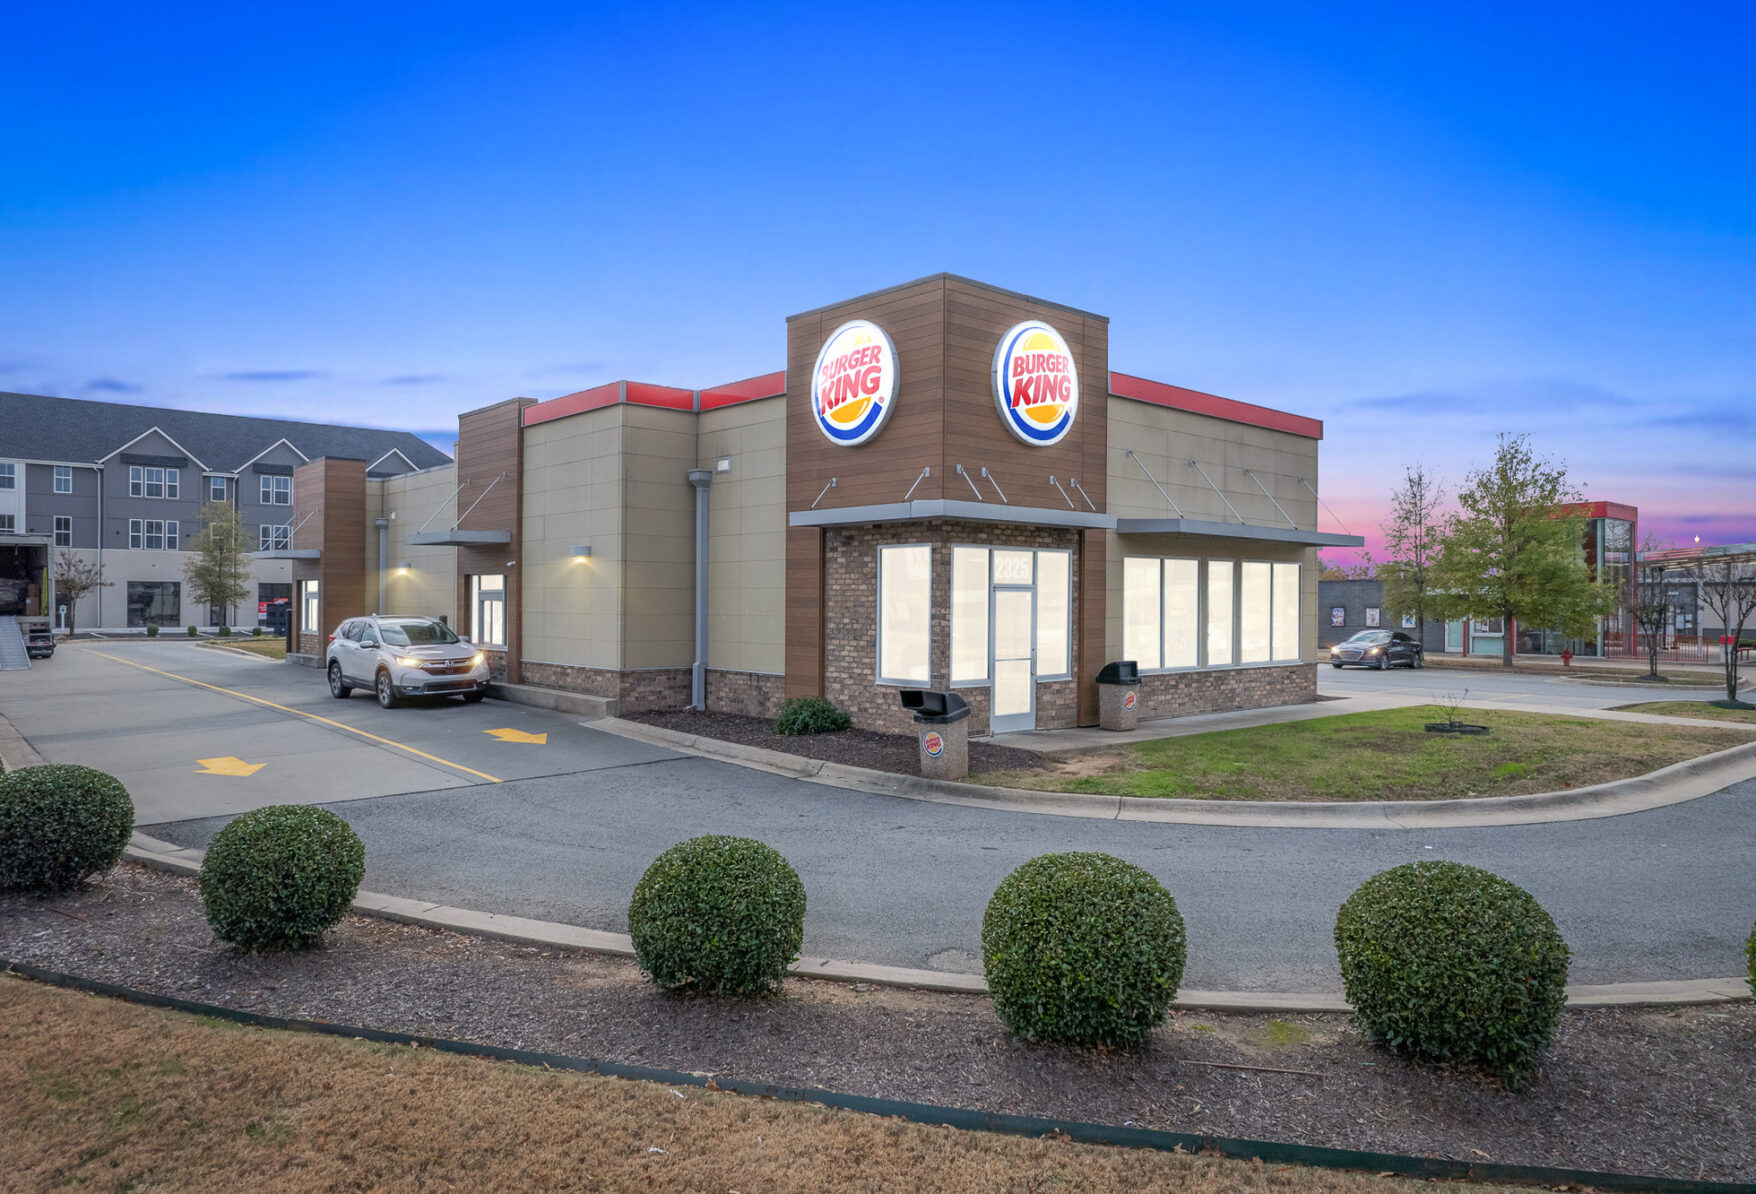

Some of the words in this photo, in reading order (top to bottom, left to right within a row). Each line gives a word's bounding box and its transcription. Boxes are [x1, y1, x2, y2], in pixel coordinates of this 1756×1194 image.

[821, 345, 882, 385] BURGER
[1012, 353, 1070, 378] BURGER
[820, 365, 882, 416] KING
[1011, 374, 1071, 408] KING
[996, 557, 1029, 579] 2325
